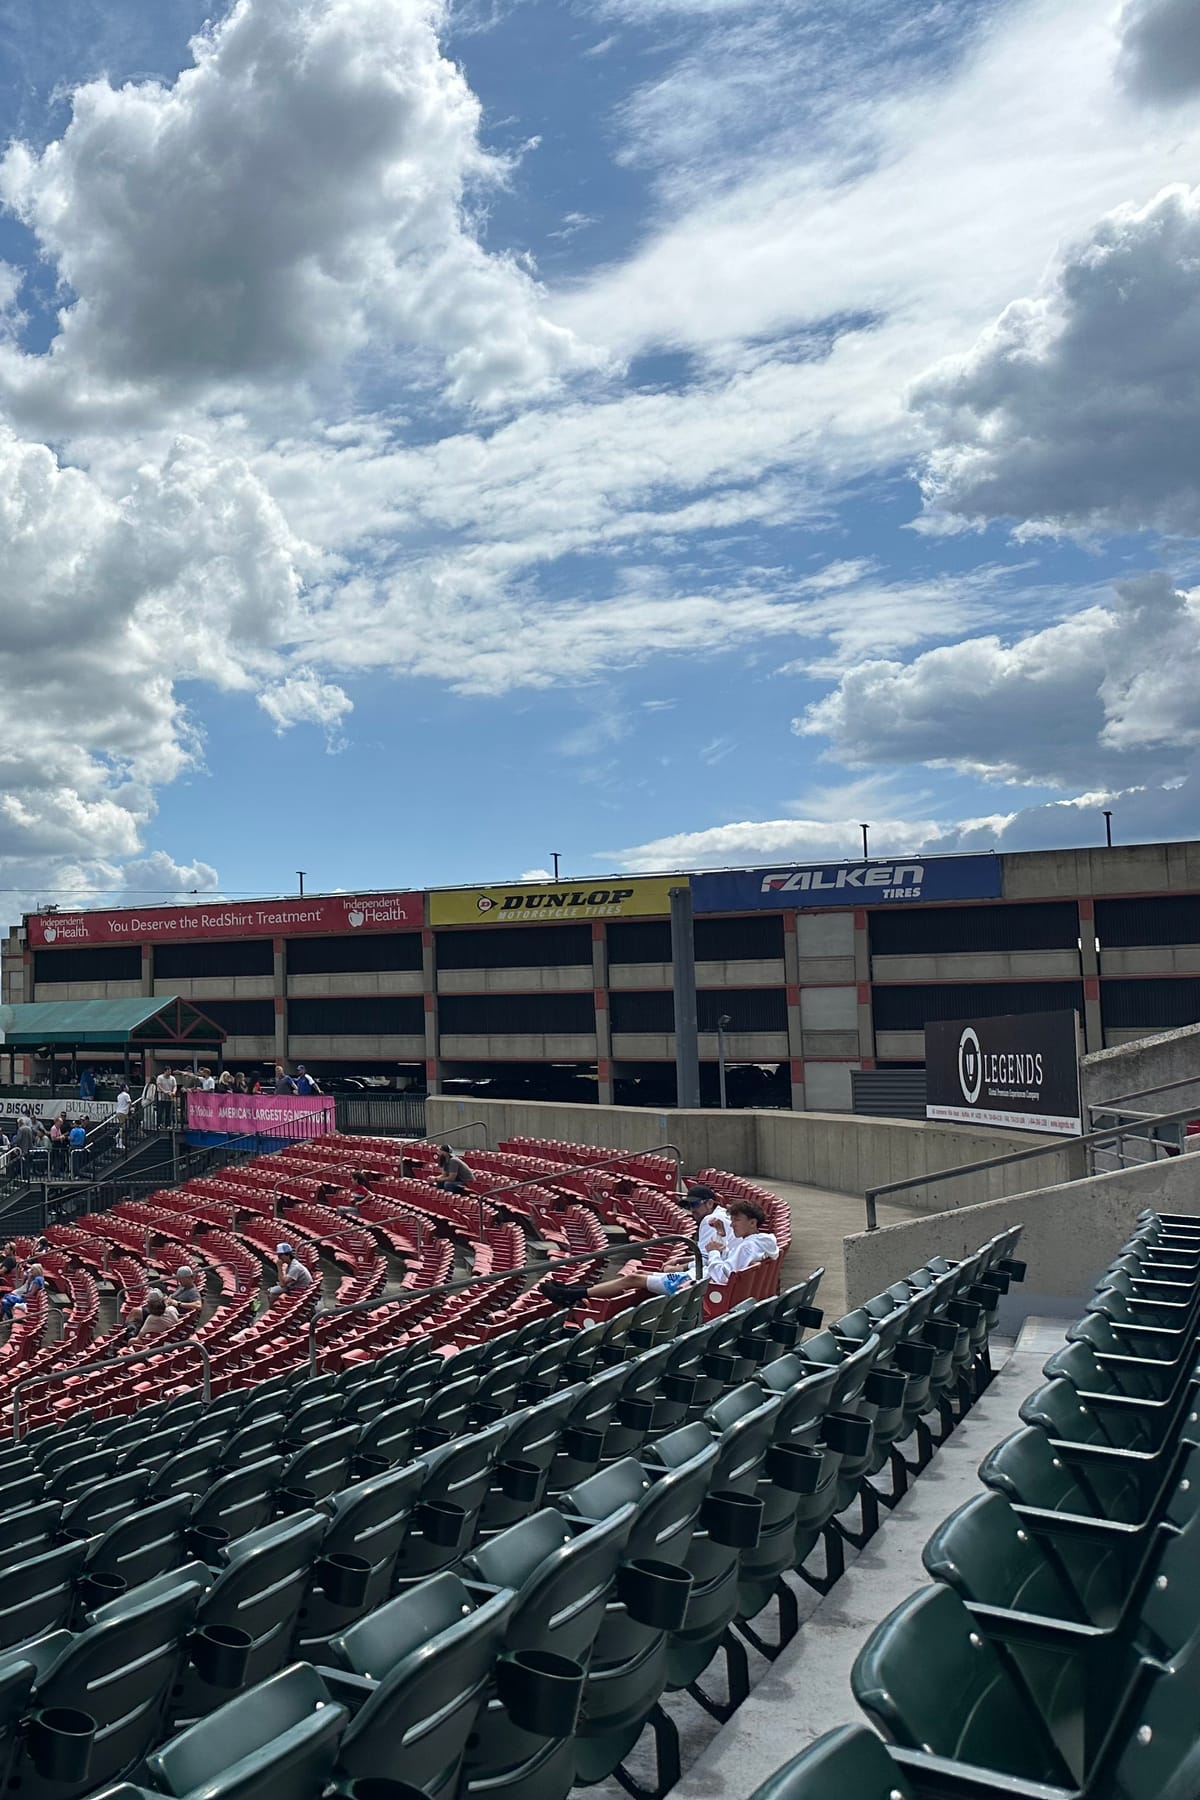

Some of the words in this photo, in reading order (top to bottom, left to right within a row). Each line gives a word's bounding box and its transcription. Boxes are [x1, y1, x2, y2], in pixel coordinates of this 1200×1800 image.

[760, 865, 925, 892] FALKEN
[882, 887, 921, 898] TIRES
[343, 898, 401, 911] Independent
[501, 889, 634, 910] DUNLOP
[365, 907, 406, 922] Health
[497, 908, 578, 920] MOTORCYCLE
[585, 905, 623, 915] TIRES
[40, 917, 84, 928] Independent
[108, 920, 129, 932] You
[131, 918, 177, 931] Deserve
[179, 915, 199, 929] the
[201, 912, 253, 928] RedShirt
[256, 909, 322, 924] Treatment
[57, 925, 89, 938] Health
[984, 1053, 1043, 1086] LEGENDS
[7, 1103, 43, 1115] BISONS!
[66, 1101, 93, 1113] BULLY
[252, 1108, 282, 1121] LARGEST
[283, 1109, 293, 1121] 5G
